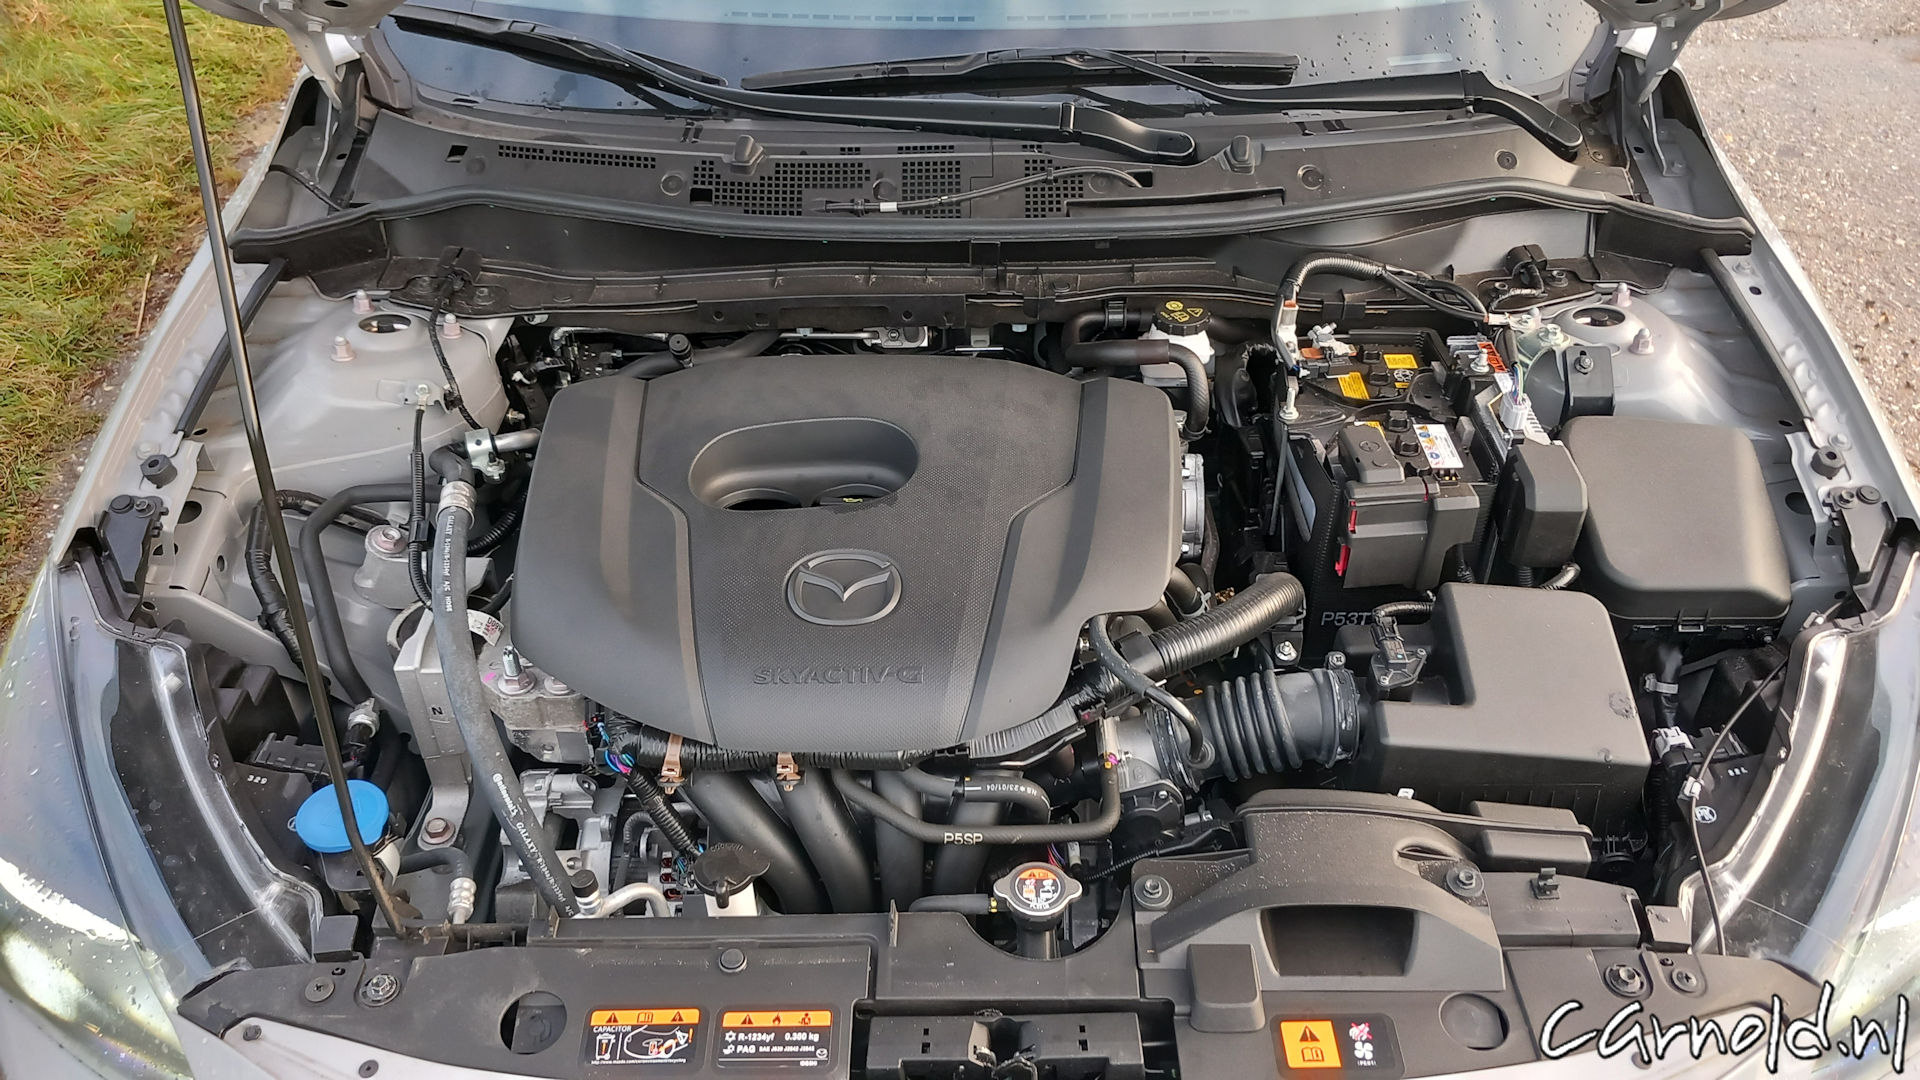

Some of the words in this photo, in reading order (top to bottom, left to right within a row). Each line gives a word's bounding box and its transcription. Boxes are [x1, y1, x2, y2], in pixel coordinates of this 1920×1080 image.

[753, 666, 924, 685] SKYACTIV-G
[516, 822, 538, 854] GALAXY
[944, 832, 983, 845] P5SP
[593, 1025, 631, 1033] CAPACITOR
[737, 1032, 775, 1042] R-1234yf
[808, 1032, 820, 1042] kg
[736, 1044, 756, 1054] PAG
